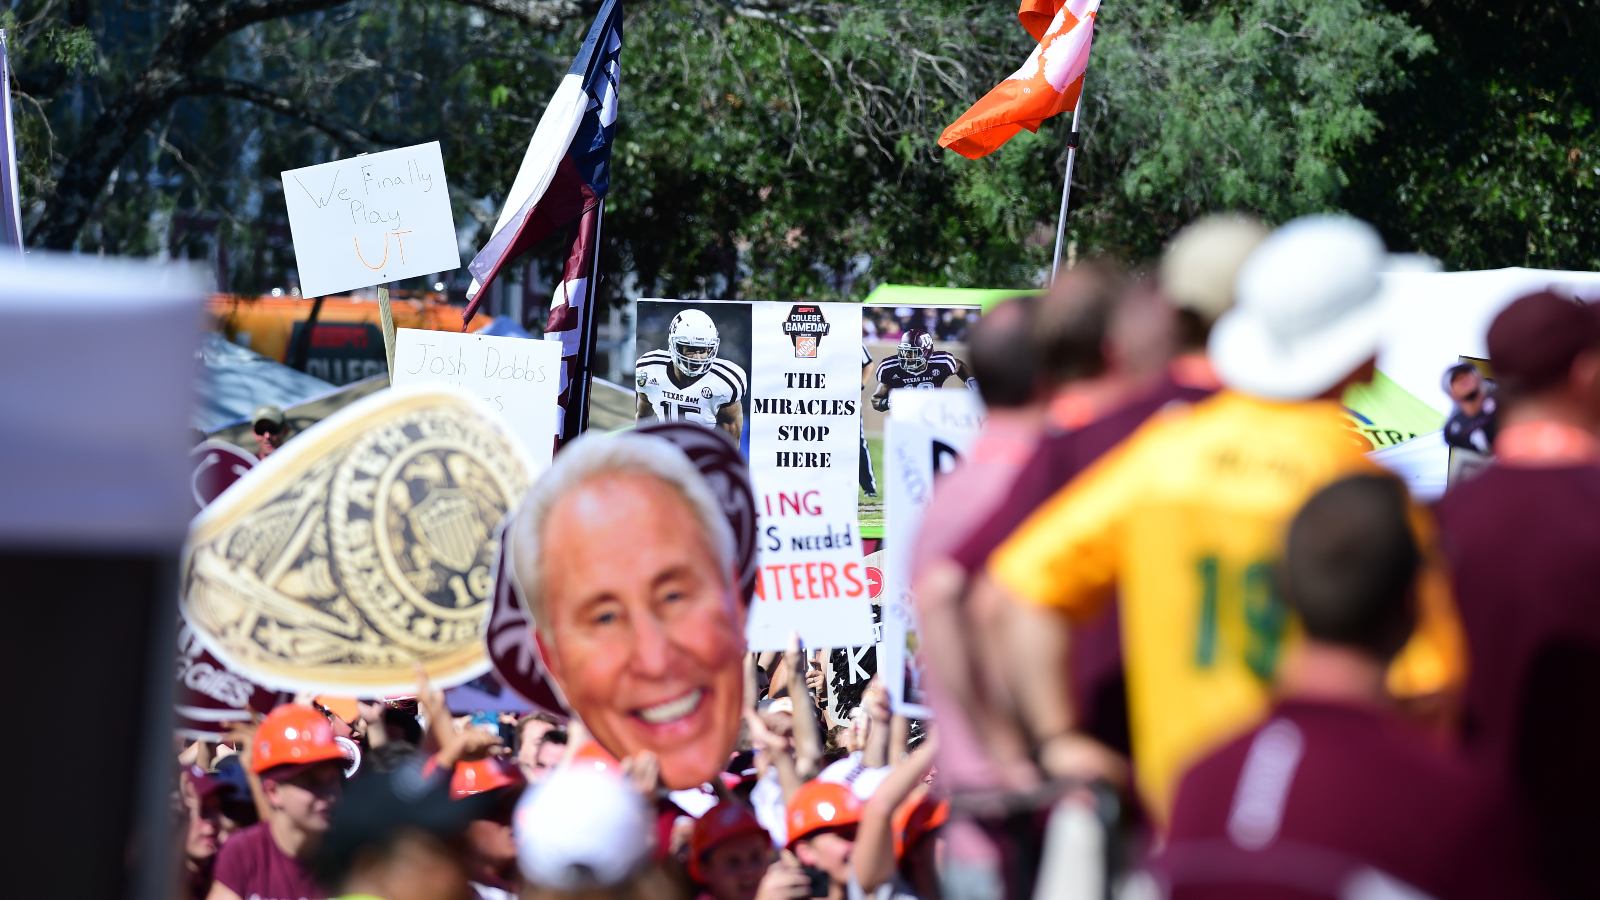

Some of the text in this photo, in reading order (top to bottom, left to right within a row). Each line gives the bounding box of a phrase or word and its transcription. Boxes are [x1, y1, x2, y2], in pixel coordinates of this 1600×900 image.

[293, 158, 433, 209] We Finally
[350, 199, 401, 231] Play
[354, 230, 413, 270] UT
[790, 314, 822, 322] COLLEGE
[785, 322, 828, 333] GAMEDAY
[406, 343, 546, 383] Josh Dobbs
[784, 372, 827, 389] THE
[662, 390, 684, 402] TEXAS
[753, 398, 856, 416] MIRACLES
[777, 425, 830, 442] STOP
[775, 451, 832, 468] HERE
[756, 490, 822, 517] ING
